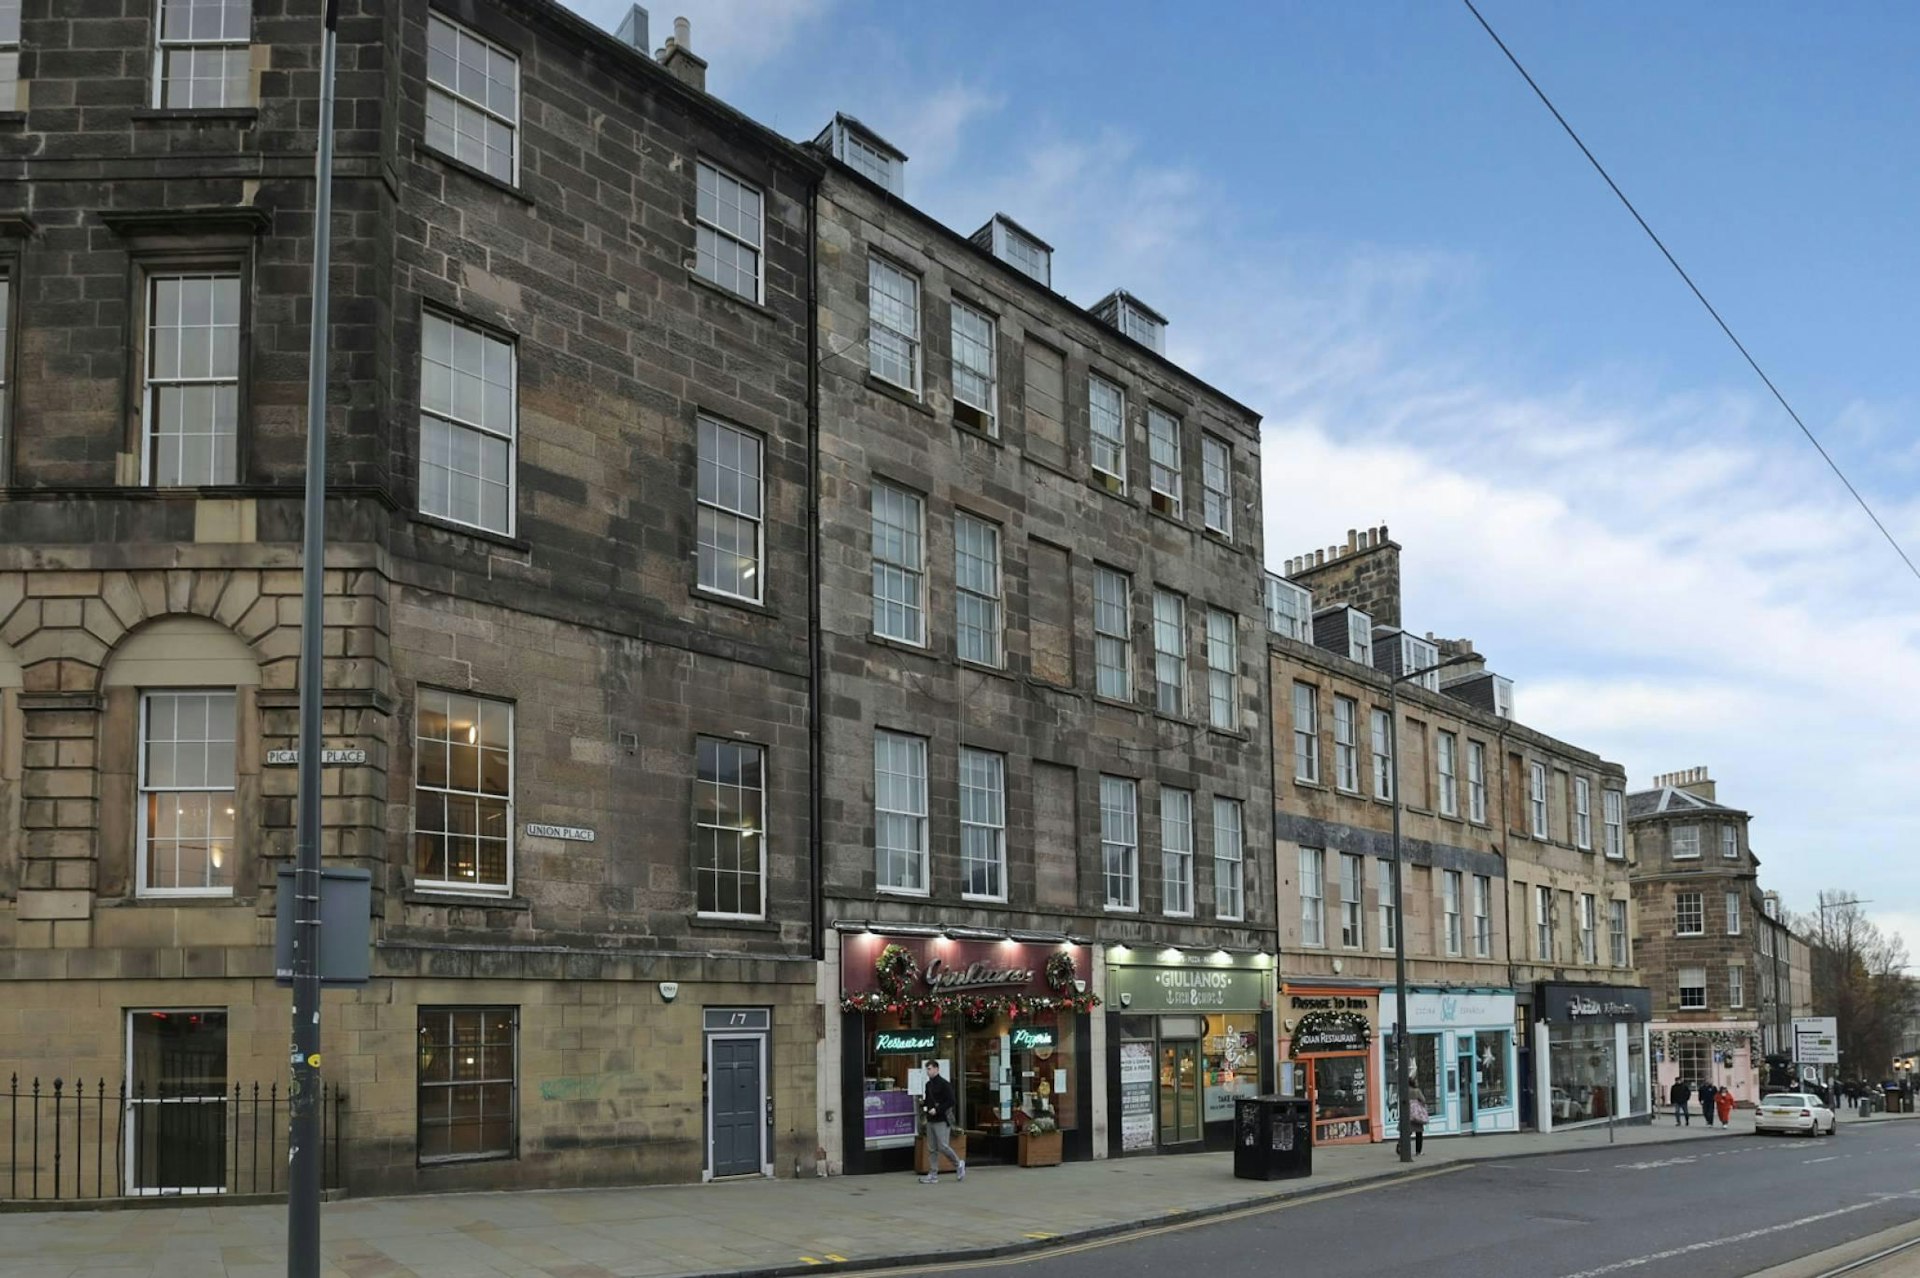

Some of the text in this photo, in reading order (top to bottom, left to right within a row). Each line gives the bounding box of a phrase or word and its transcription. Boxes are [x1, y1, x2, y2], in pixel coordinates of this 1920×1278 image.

[326, 751, 364, 762] PLACE
[529, 825, 593, 840] UNION PLACE
[1161, 970, 1228, 989] GIULIANOS
[1190, 988, 1198, 1005] &
[1291, 996, 1332, 1009] PASSAGE
[1333, 996, 1345, 1009] TO
[876, 1034, 935, 1050] Restaurant
